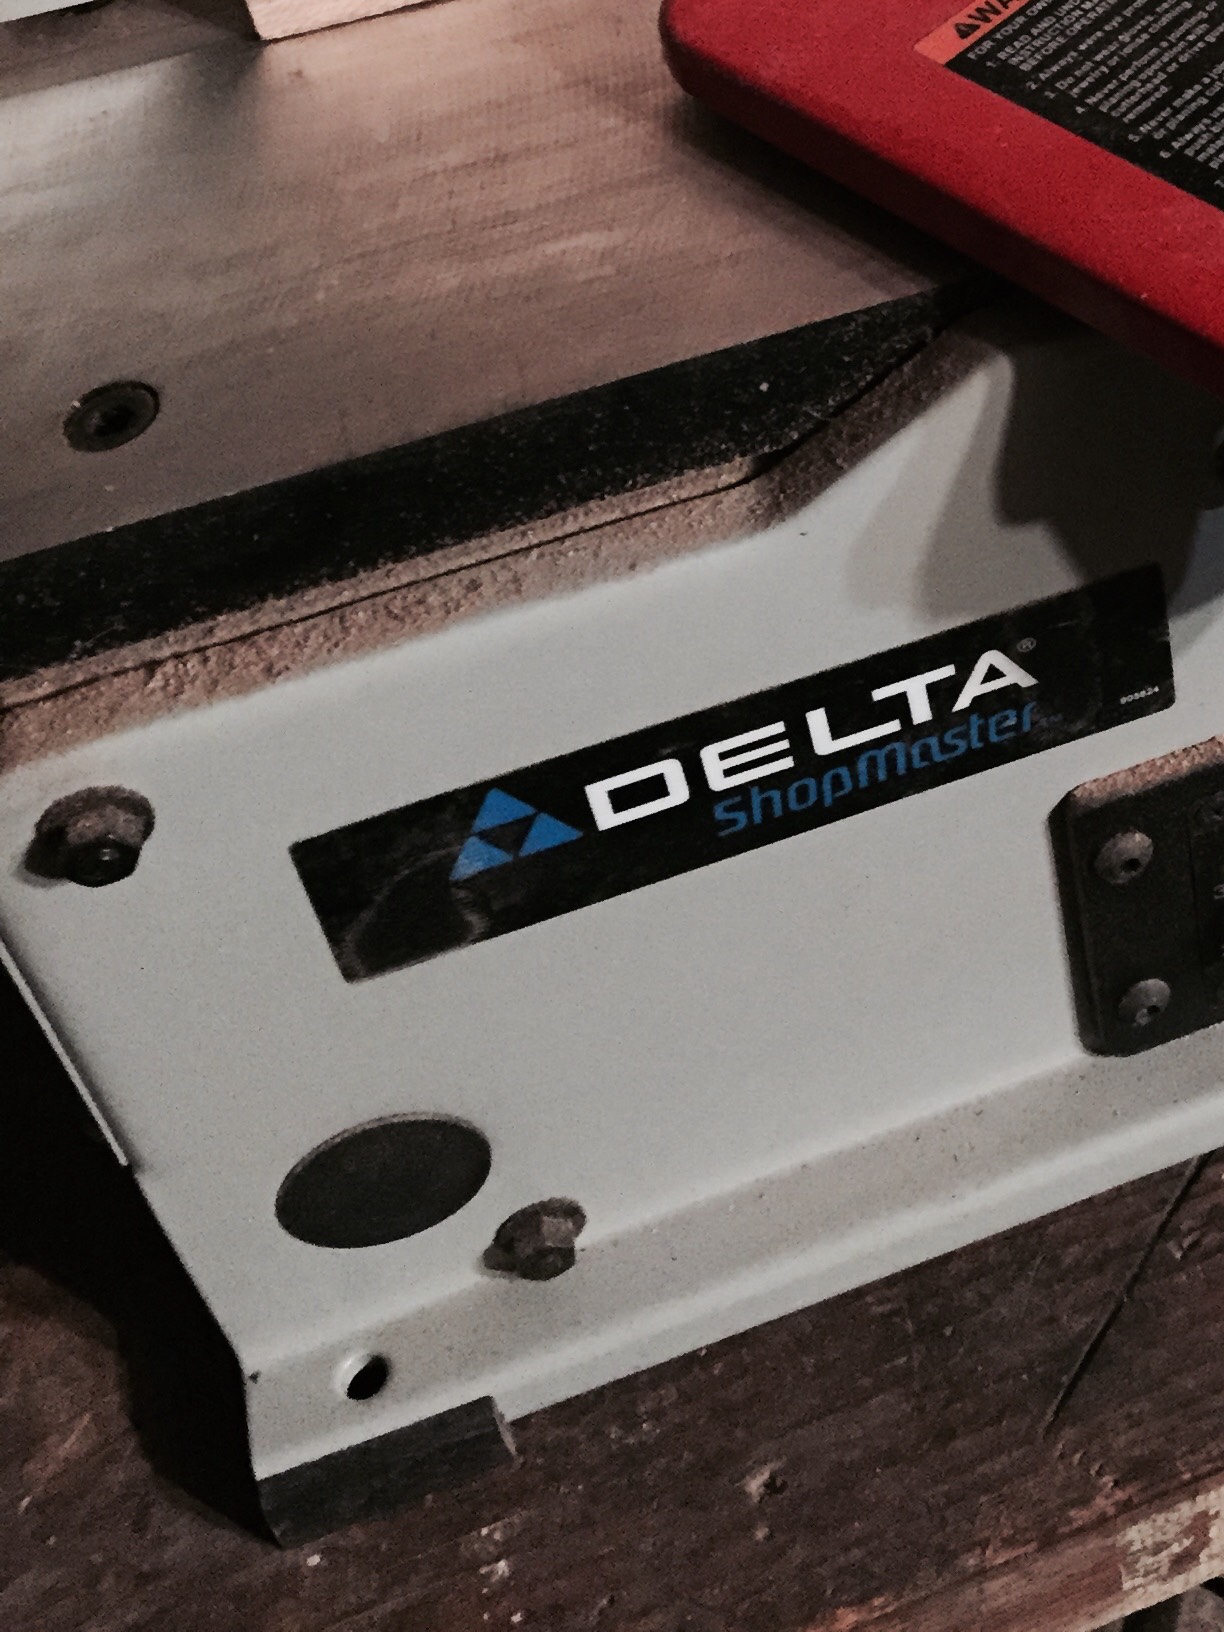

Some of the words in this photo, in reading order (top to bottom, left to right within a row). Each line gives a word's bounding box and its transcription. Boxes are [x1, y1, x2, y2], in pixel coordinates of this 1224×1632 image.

[965, 39, 998, 61] FOR
[992, 14, 1030, 40] YOUR
[994, 33, 1034, 61] READ
[1026, 14, 1058, 36] AND
[1006, 8, 1085, 66] INSTRUCTION
[1017, 34, 1070, 72] BEFORE
[584, 649, 1039, 832] DELTA
[712, 700, 1038, 838] ShopMaster
